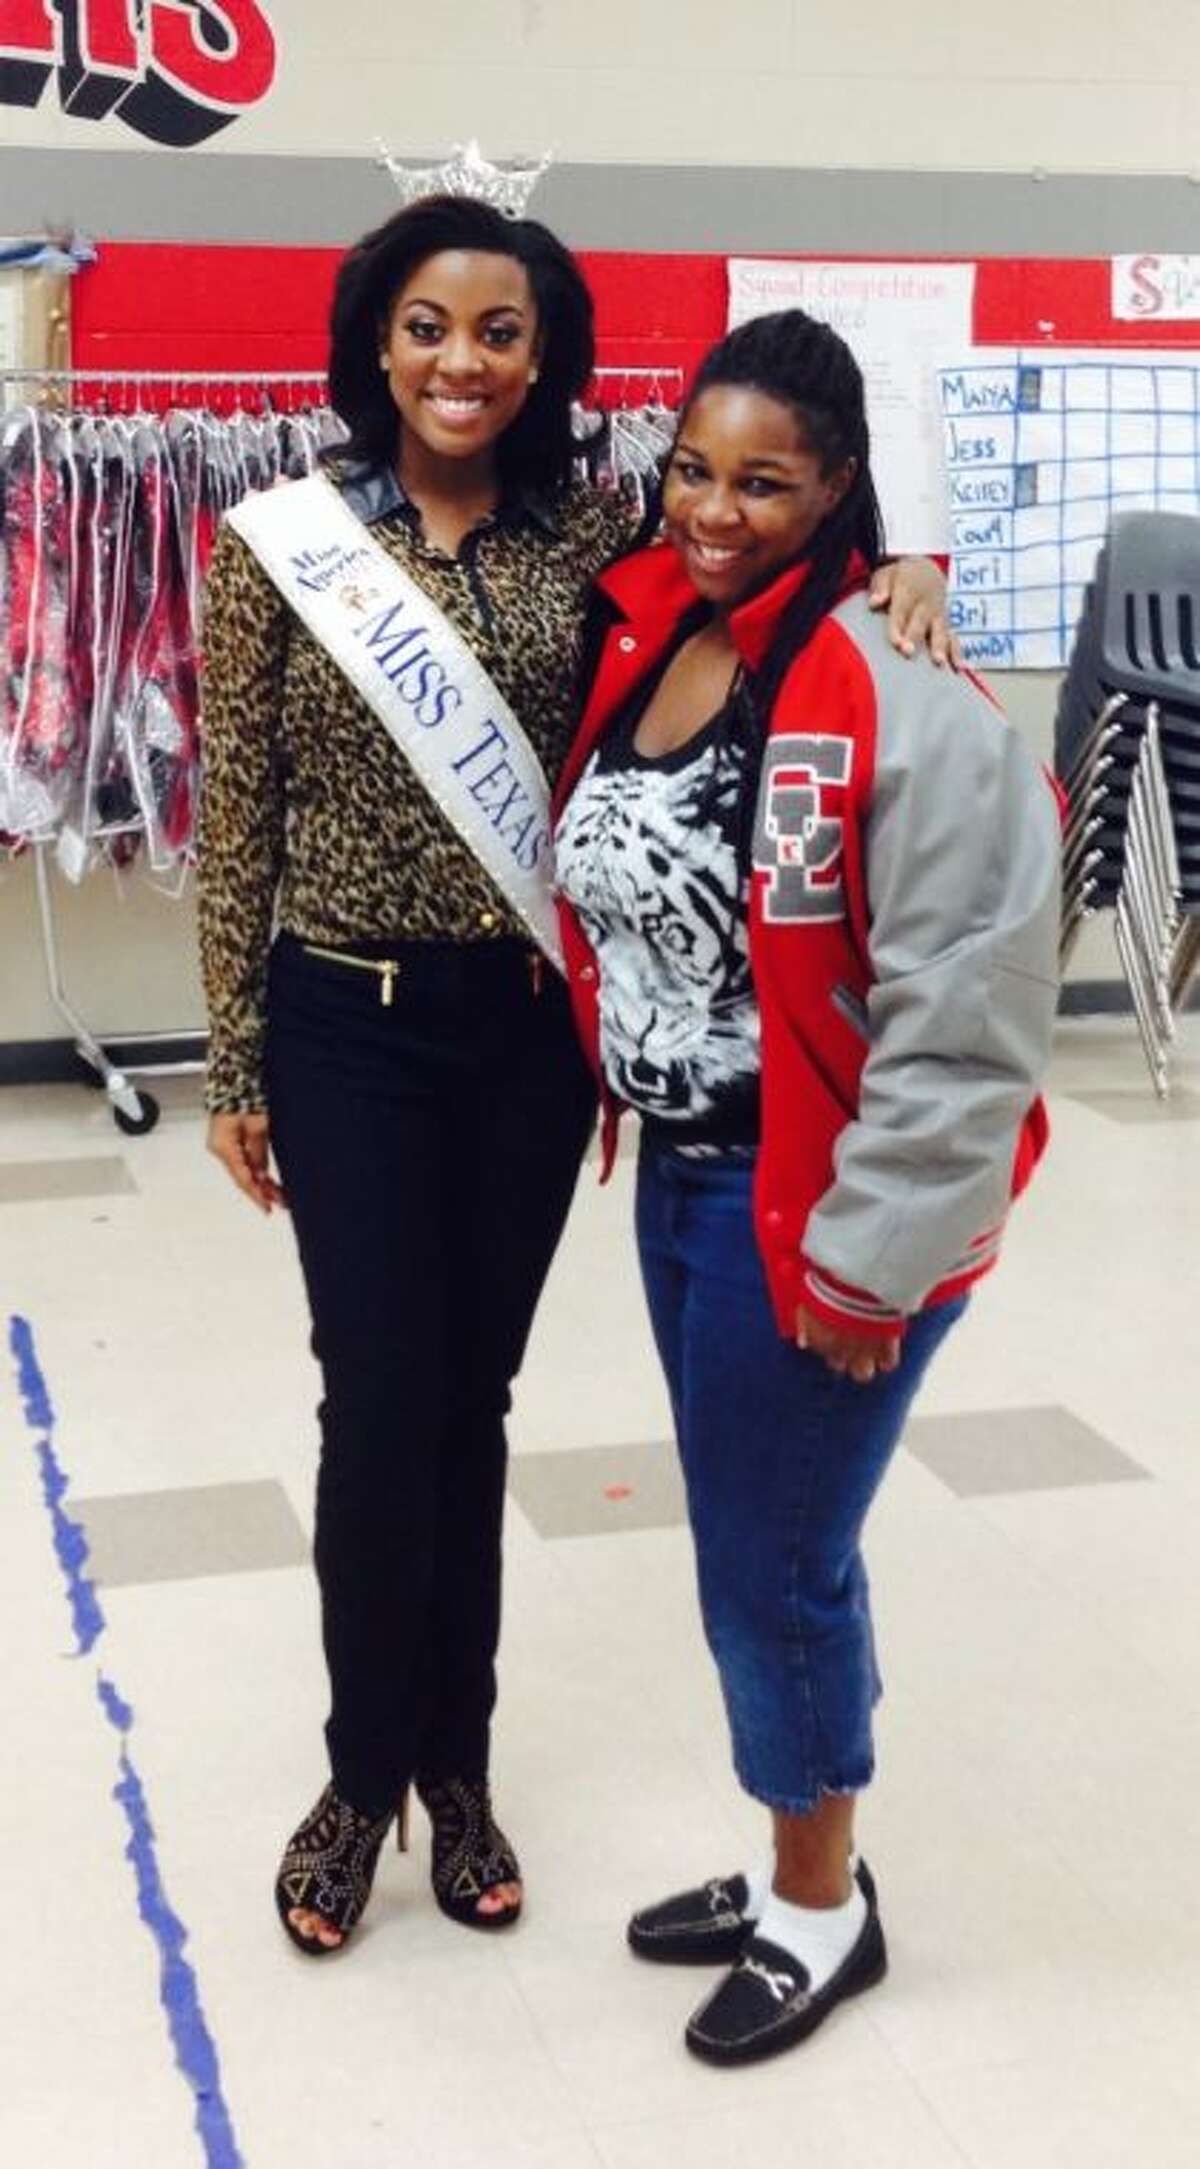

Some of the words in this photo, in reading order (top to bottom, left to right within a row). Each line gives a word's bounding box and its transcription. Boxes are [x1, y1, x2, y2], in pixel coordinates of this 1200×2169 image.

[948, 420, 996, 461] JESS
[297, 547, 370, 592] America
[955, 556, 999, 586] Tori
[950, 599, 986, 627] Bri
[353, 602, 462, 728] MISS
[451, 718, 550, 871] TEXAS
